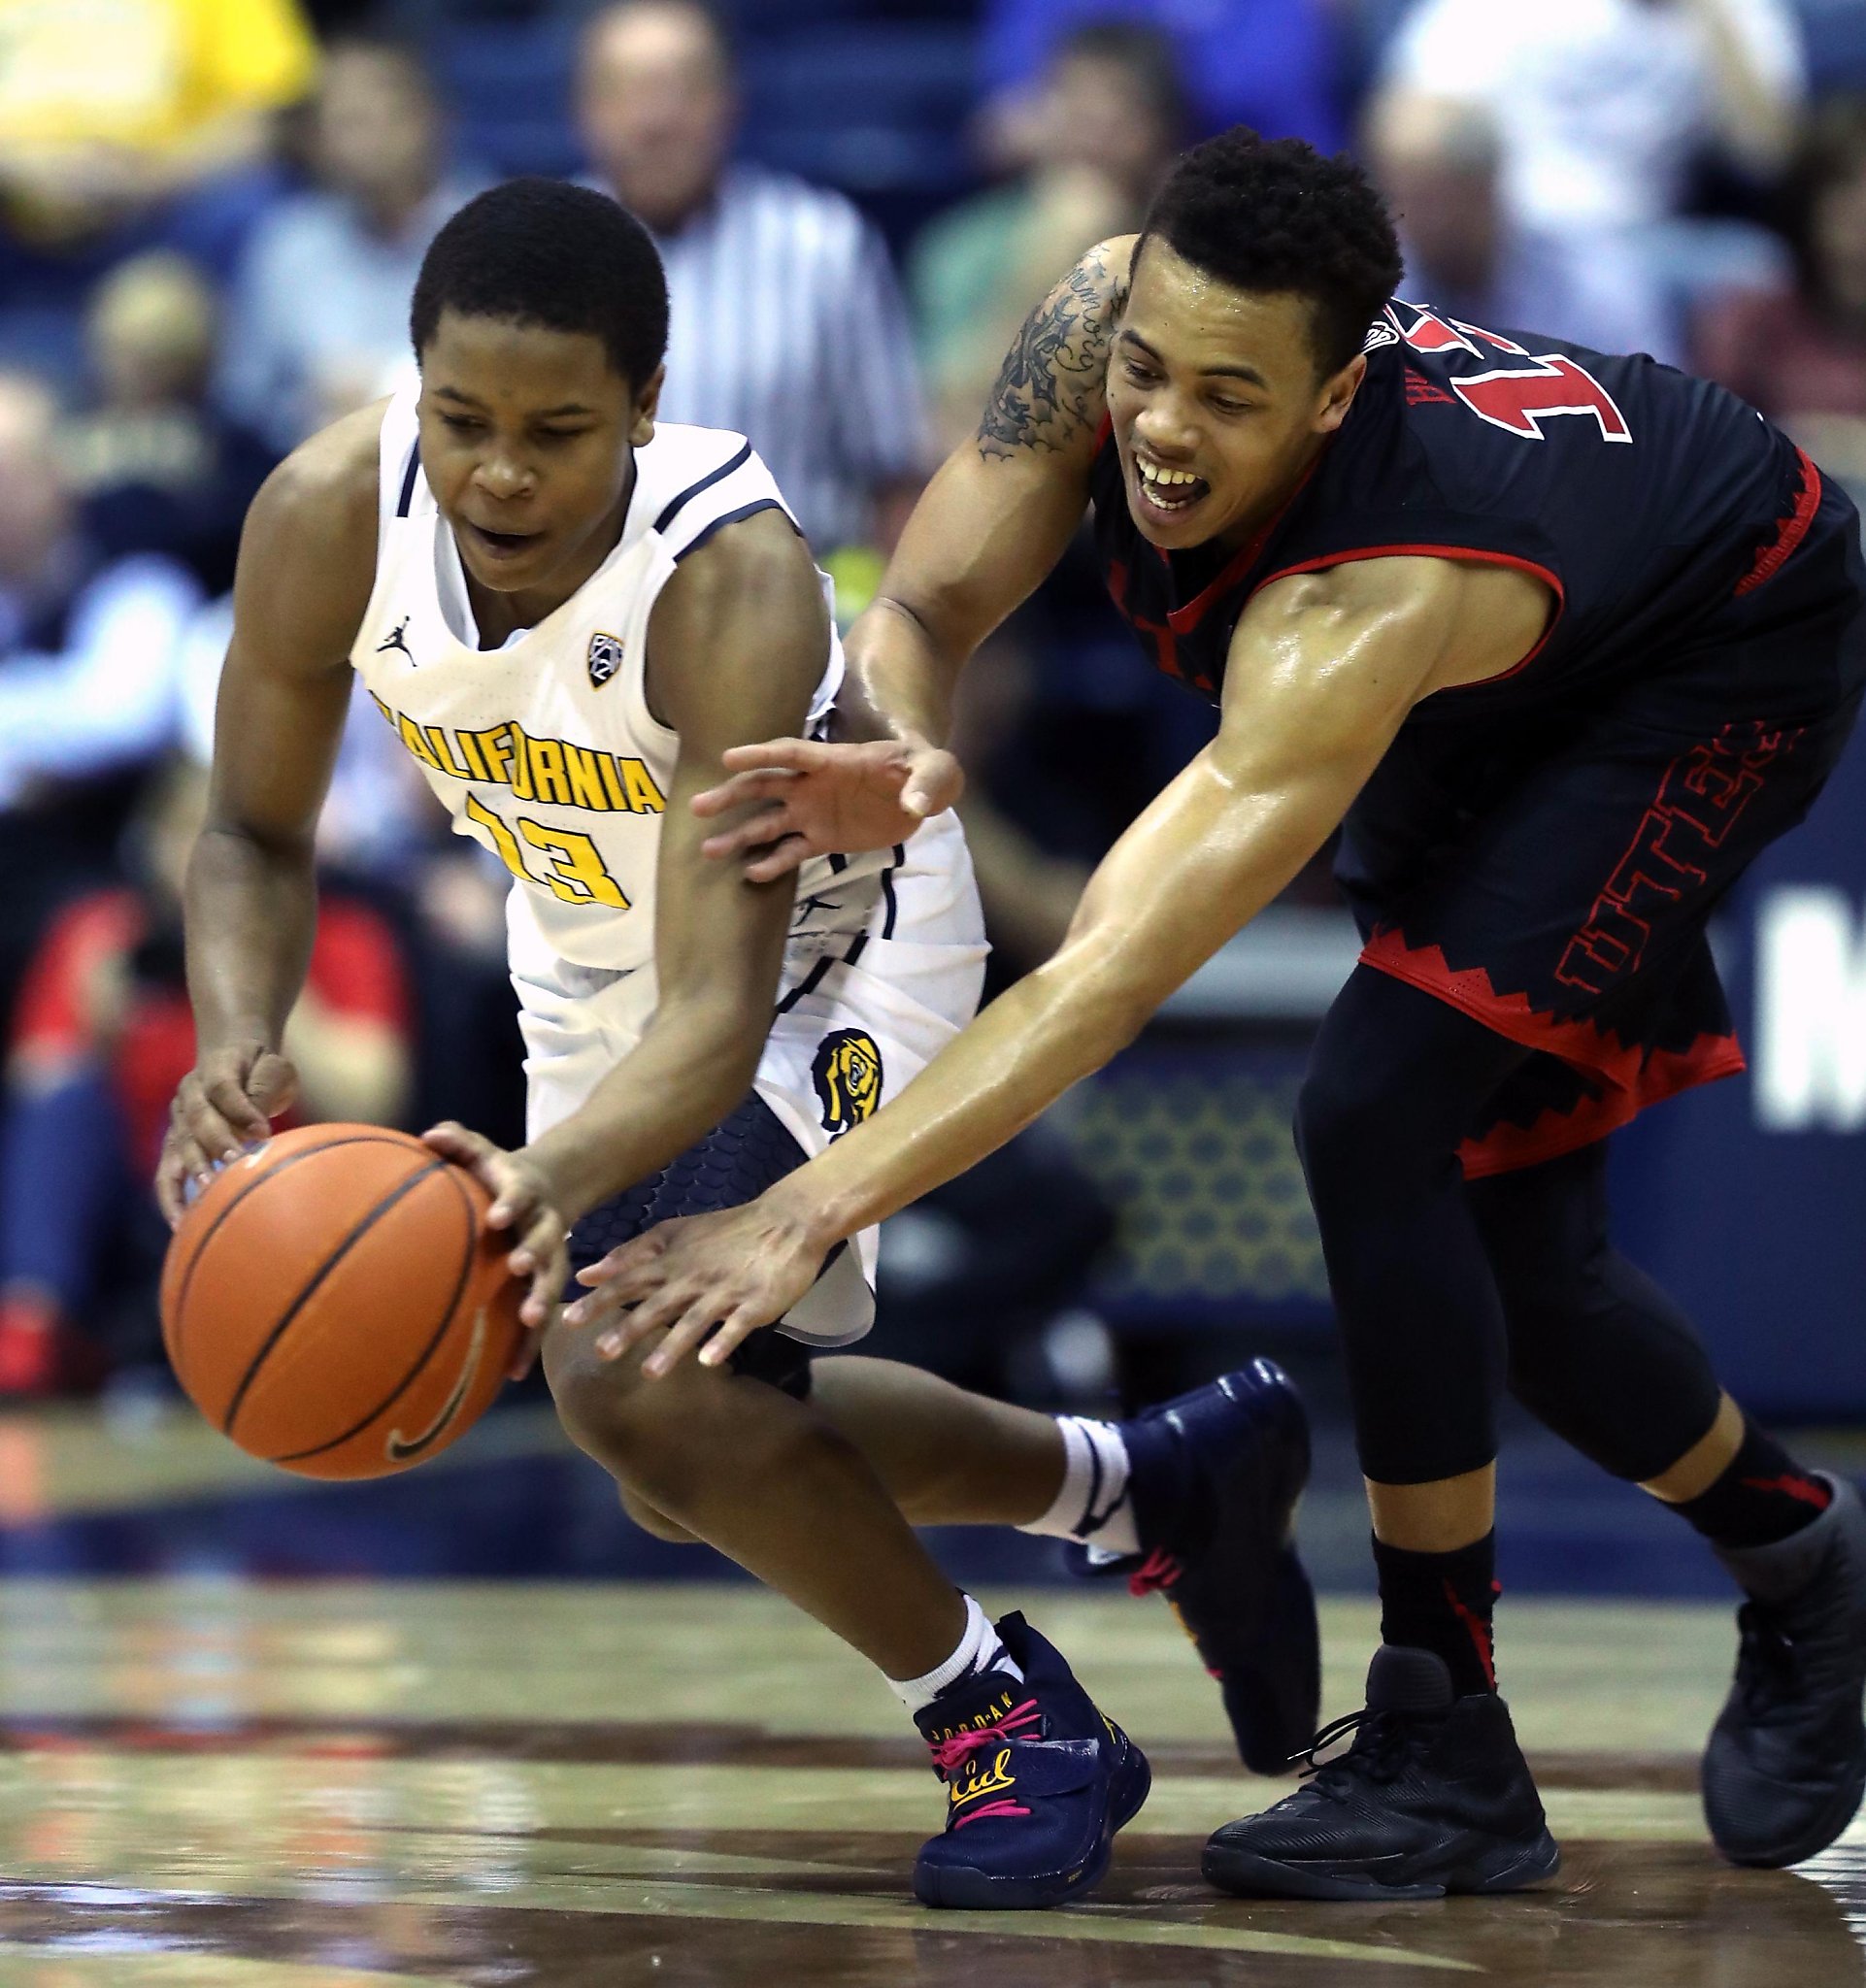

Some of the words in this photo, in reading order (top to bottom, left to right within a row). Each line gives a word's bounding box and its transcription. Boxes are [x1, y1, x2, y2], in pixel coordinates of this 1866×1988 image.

[368, 689, 667, 814] ALIFORNIA
[467, 791, 632, 911] 13
[932, 1691, 1013, 1740] JORDAN
